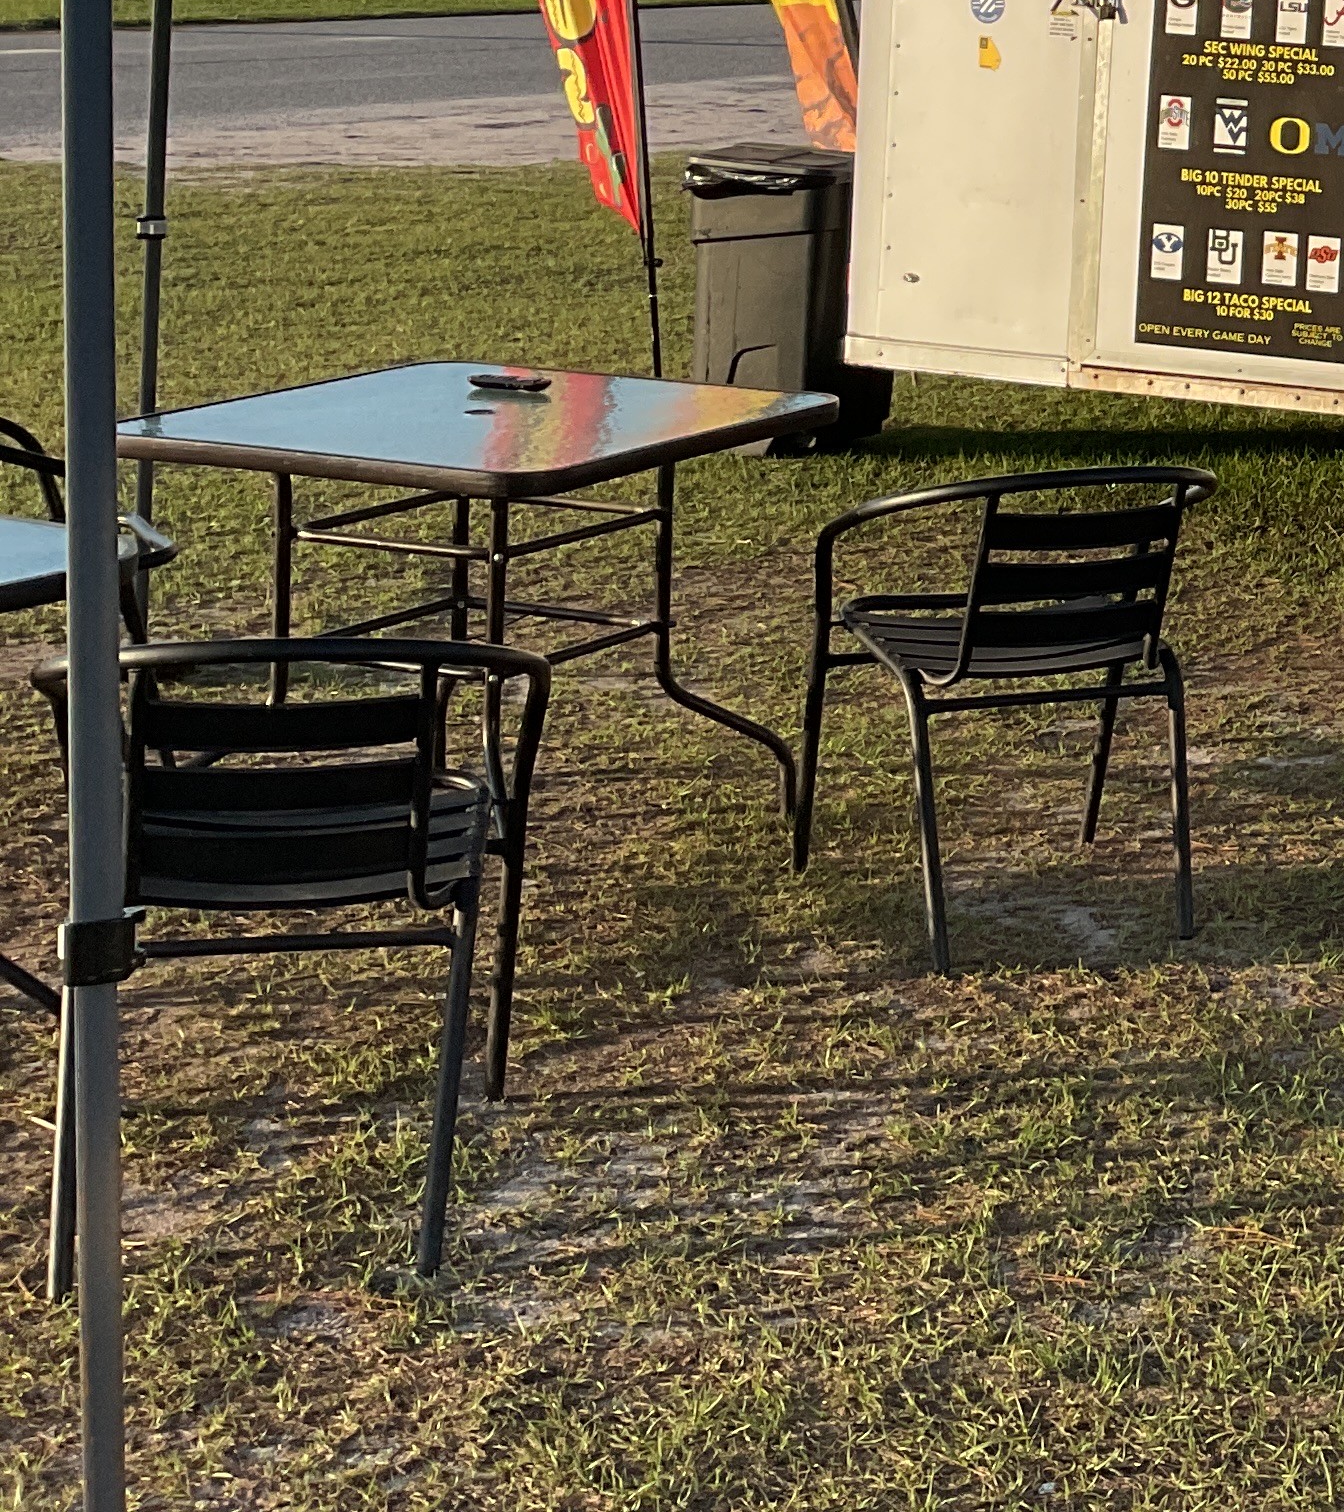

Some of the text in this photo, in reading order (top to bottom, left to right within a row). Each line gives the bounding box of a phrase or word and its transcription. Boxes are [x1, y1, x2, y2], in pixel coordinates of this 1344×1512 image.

[1280, 0, 1308, 13] LSU
[1204, 41, 1318, 61] SEC WING SPECIAL
[1182, 54, 1334, 76] 20 PC $22.00 30 PC $33.00
[1222, 69, 1295, 85] 50 PC $55.00
[1269, 117, 1311, 155] O
[1181, 169, 1322, 193] BIG 10 TENDER SPECIAL
[1196, 185, 1305, 204] 10PC $20 20PC $38
[1225, 198, 1277, 213] 30PC $55
[1183, 288, 1312, 313] BIG 12 TACO SPECIAL
[1215, 306, 1274, 321] 10 FOR $30
[1138, 323, 1271, 345] OPEN EVERY GAME DAY
[1291, 329, 1343, 341] SUBJECT TO
[1294, 322, 1342, 334] PRICES ARE
[1298, 337, 1333, 348] CHANGE
